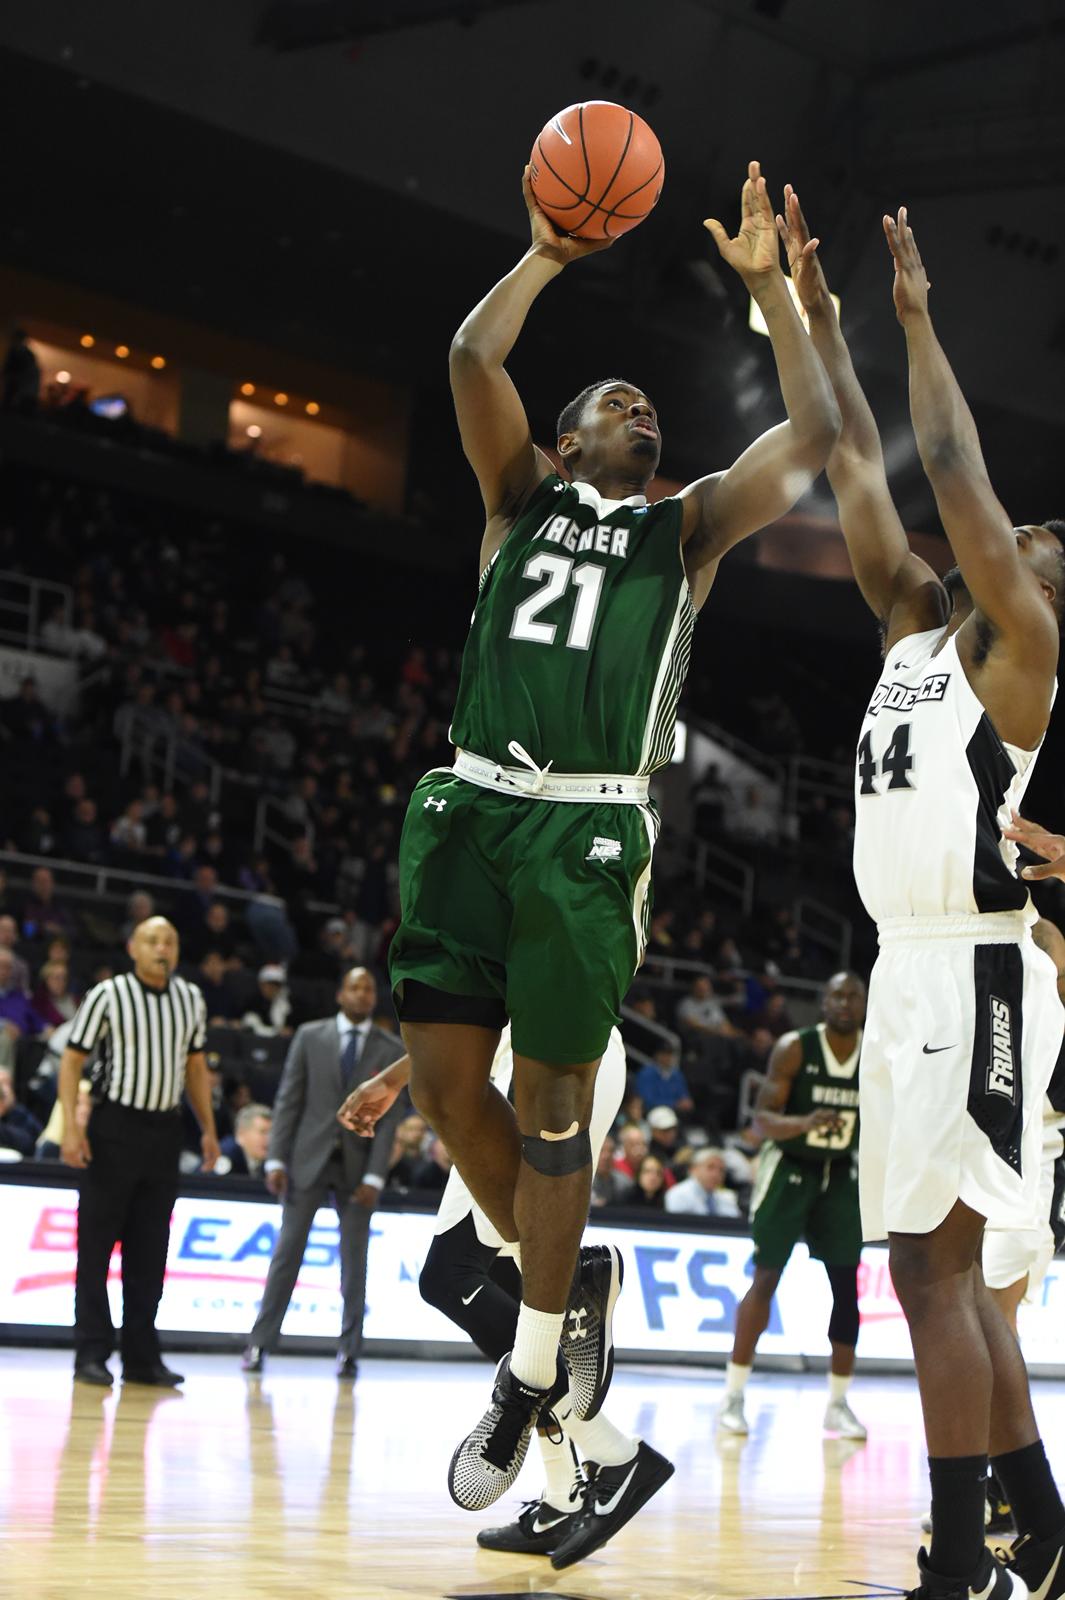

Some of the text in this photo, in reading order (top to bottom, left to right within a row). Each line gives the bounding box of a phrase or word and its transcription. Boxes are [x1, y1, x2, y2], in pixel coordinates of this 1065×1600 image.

[508, 551, 607, 651] 21
[857, 723, 917, 796] 44
[986, 996, 1016, 1101] FRIARS
[178, 1217, 384, 1268] EAS
[856, 1262, 898, 1300] BI
